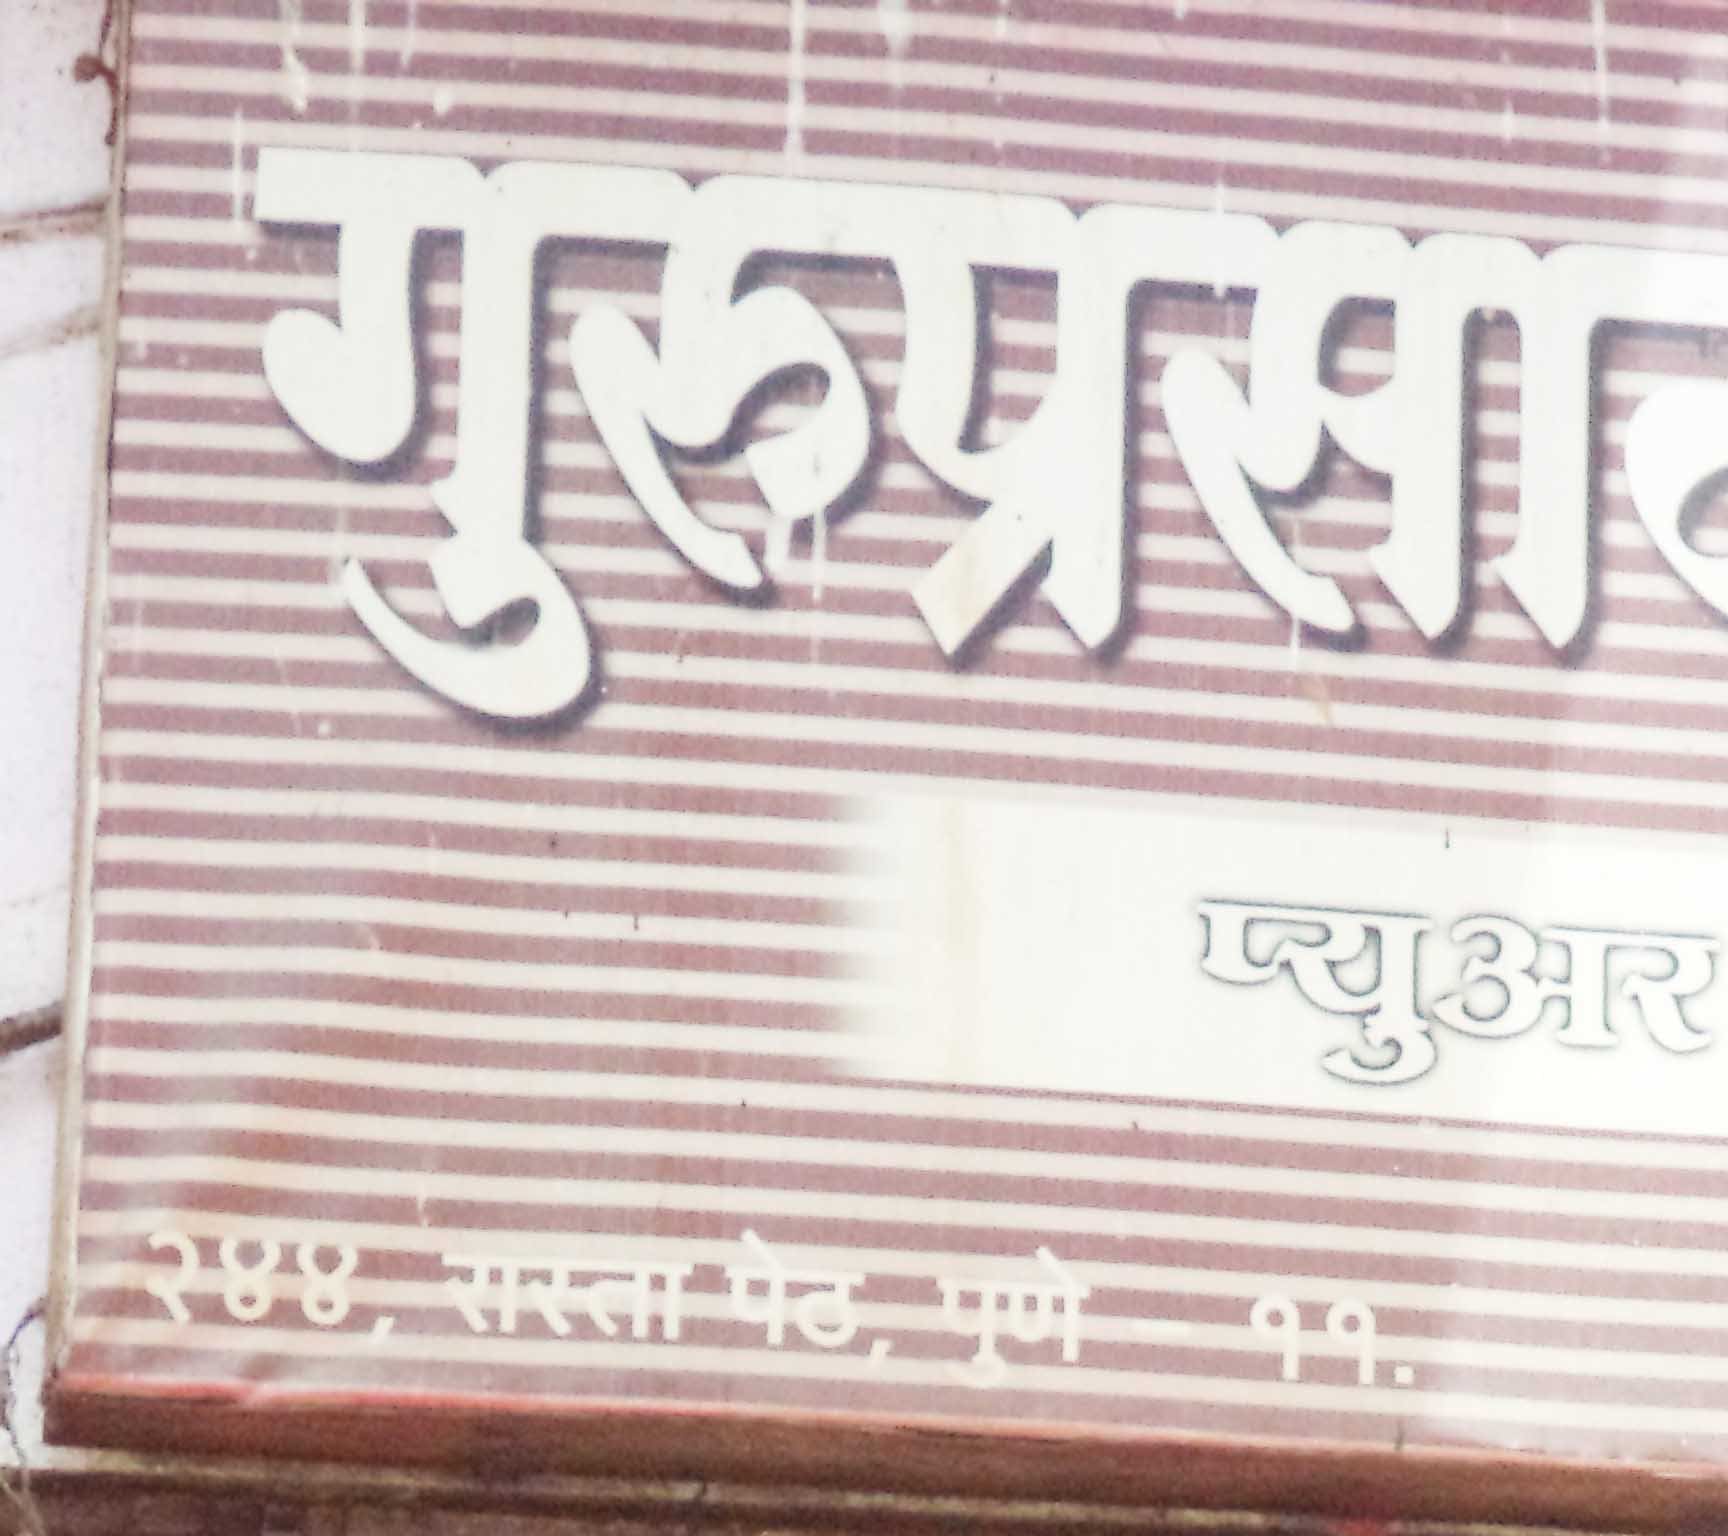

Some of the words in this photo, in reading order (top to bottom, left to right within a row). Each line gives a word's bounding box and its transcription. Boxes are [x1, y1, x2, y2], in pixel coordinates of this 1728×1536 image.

[1198, 897, 1722, 1087] प्युअर
[147, 1230, 396, 1344] २४४,
[932, 1245, 1092, 1388] पुणे
